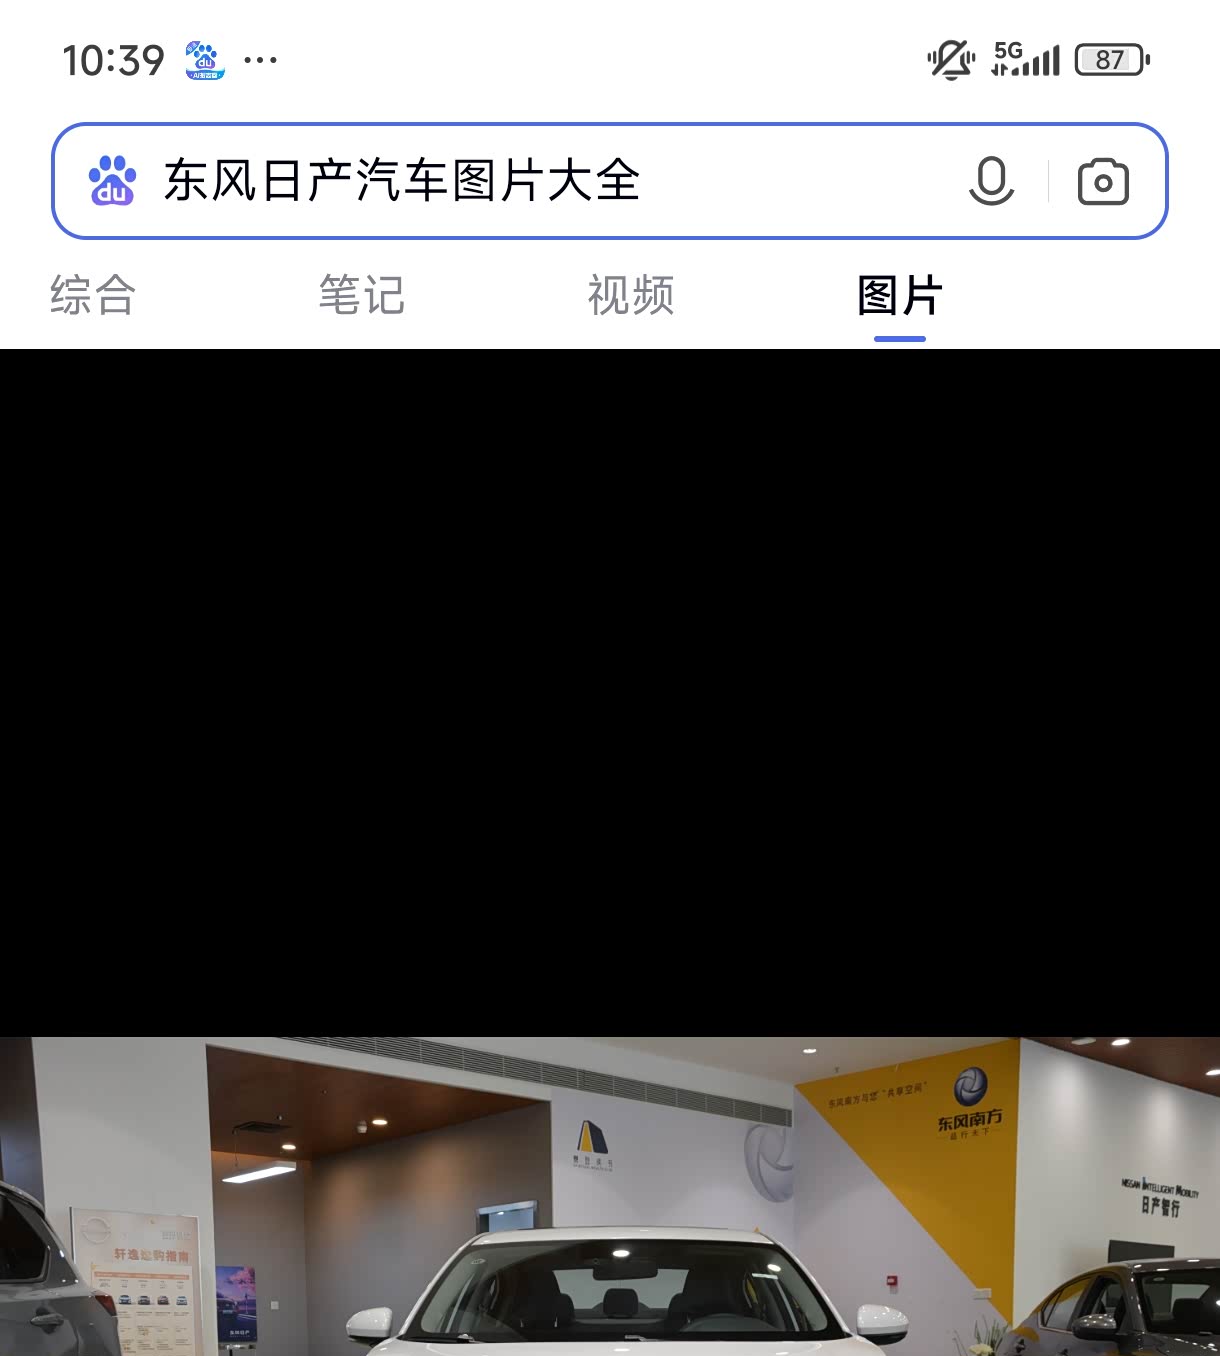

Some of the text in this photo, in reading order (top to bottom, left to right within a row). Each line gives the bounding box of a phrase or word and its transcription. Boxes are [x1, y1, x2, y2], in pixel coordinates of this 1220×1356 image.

[64, 43, 165, 77] 10:39
[995, 41, 1023, 59] 5G
[1096, 50, 1124, 70] 87
[97, 182, 126, 202] du
[164, 156, 640, 203] 东风日产汽车图片大全
[50, 273, 136, 316] 综合
[319, 273, 405, 315] 笔记
[587, 273, 674, 316] 视频
[858, 273, 943, 316] 图片
[938, 1108, 1002, 1132] 东风南方
[1121, 1178, 1141, 1189] NISSAN
[1142, 1195, 1180, 1218] 日产智行
